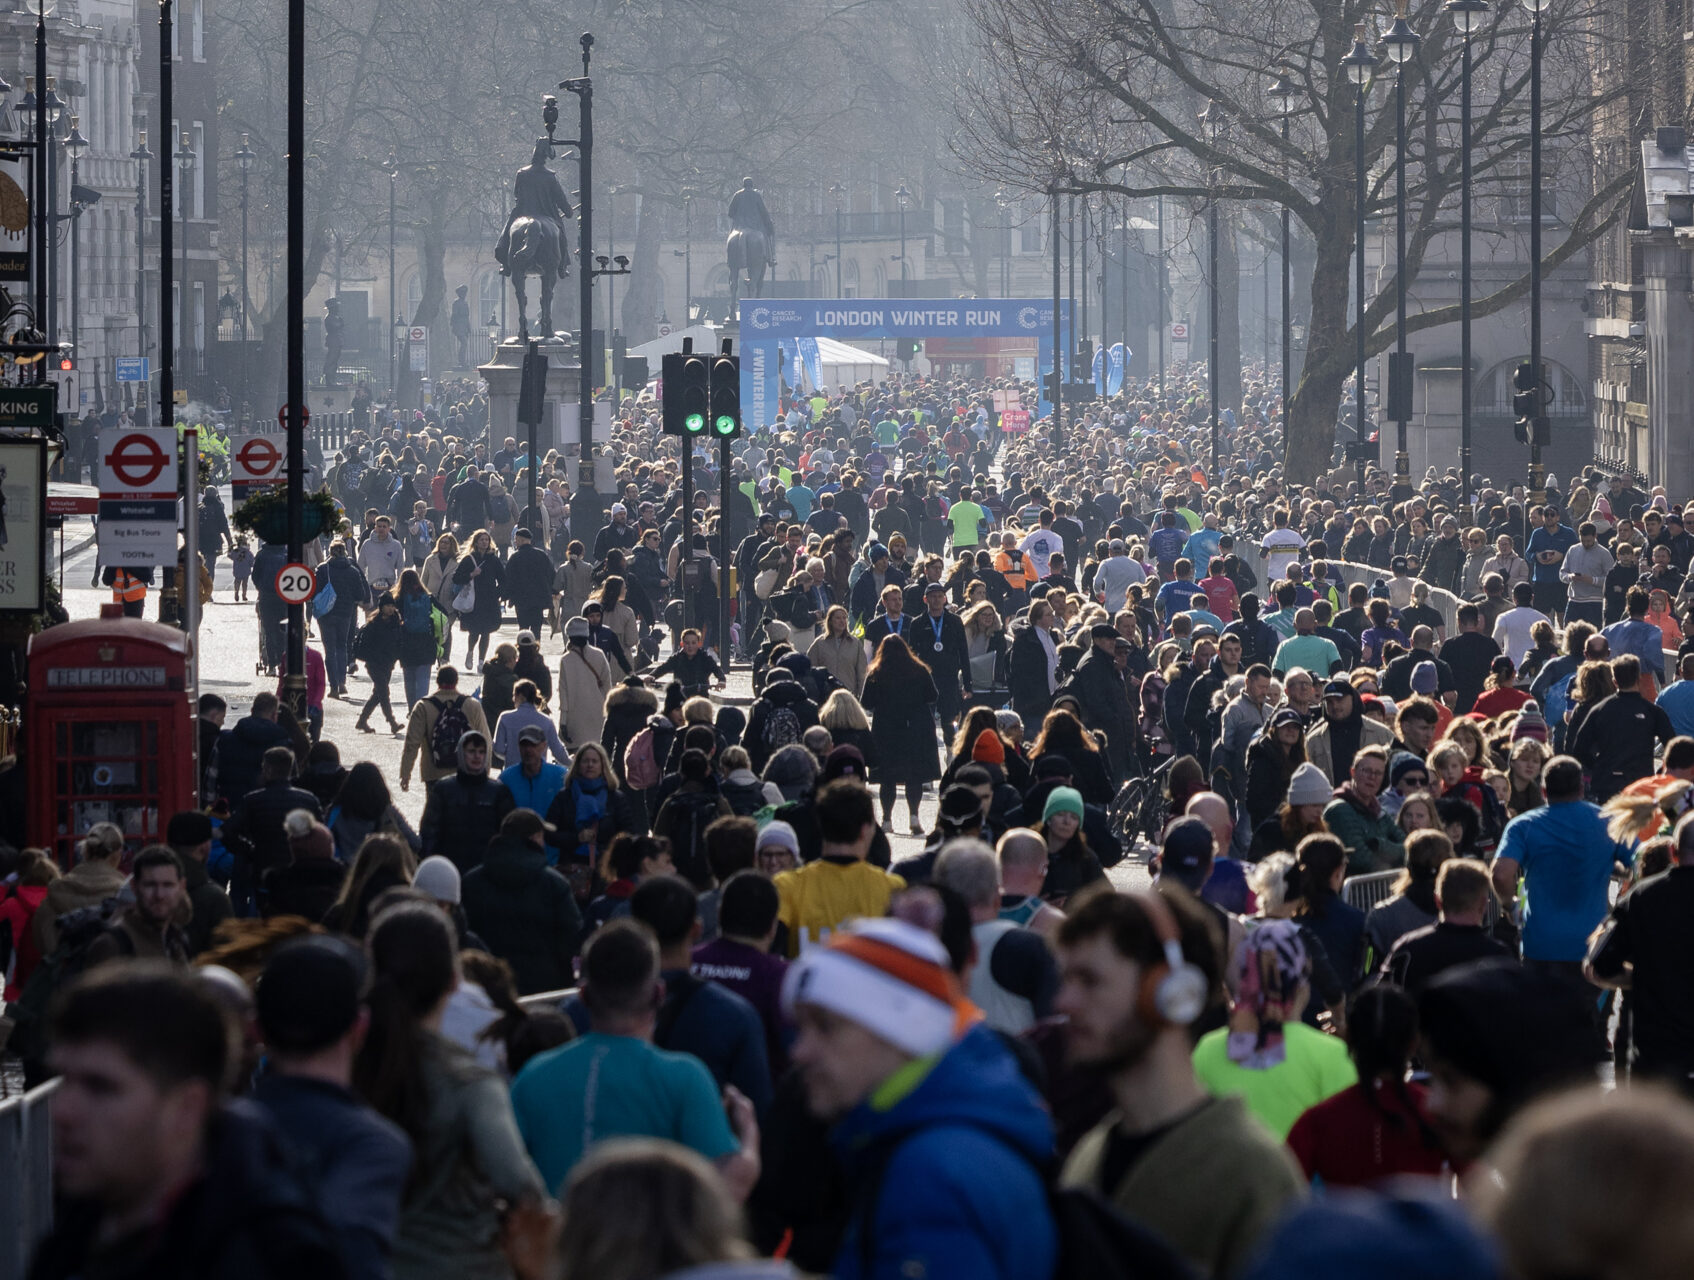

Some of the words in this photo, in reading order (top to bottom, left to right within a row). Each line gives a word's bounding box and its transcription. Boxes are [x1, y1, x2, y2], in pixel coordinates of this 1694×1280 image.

[815, 310, 884, 326] LONDON
[891, 310, 958, 326] WINTER
[965, 310, 1001, 326] RUN
[1004, 412, 1027, 421] Cross
[1005, 421, 1026, 429] Here
[114, 529, 125, 538] Big
[126, 529, 140, 537] Bus
[141, 529, 161, 537] Tours
[282, 575, 311, 592] 20
[55, 669, 160, 685] TELEPHONE
